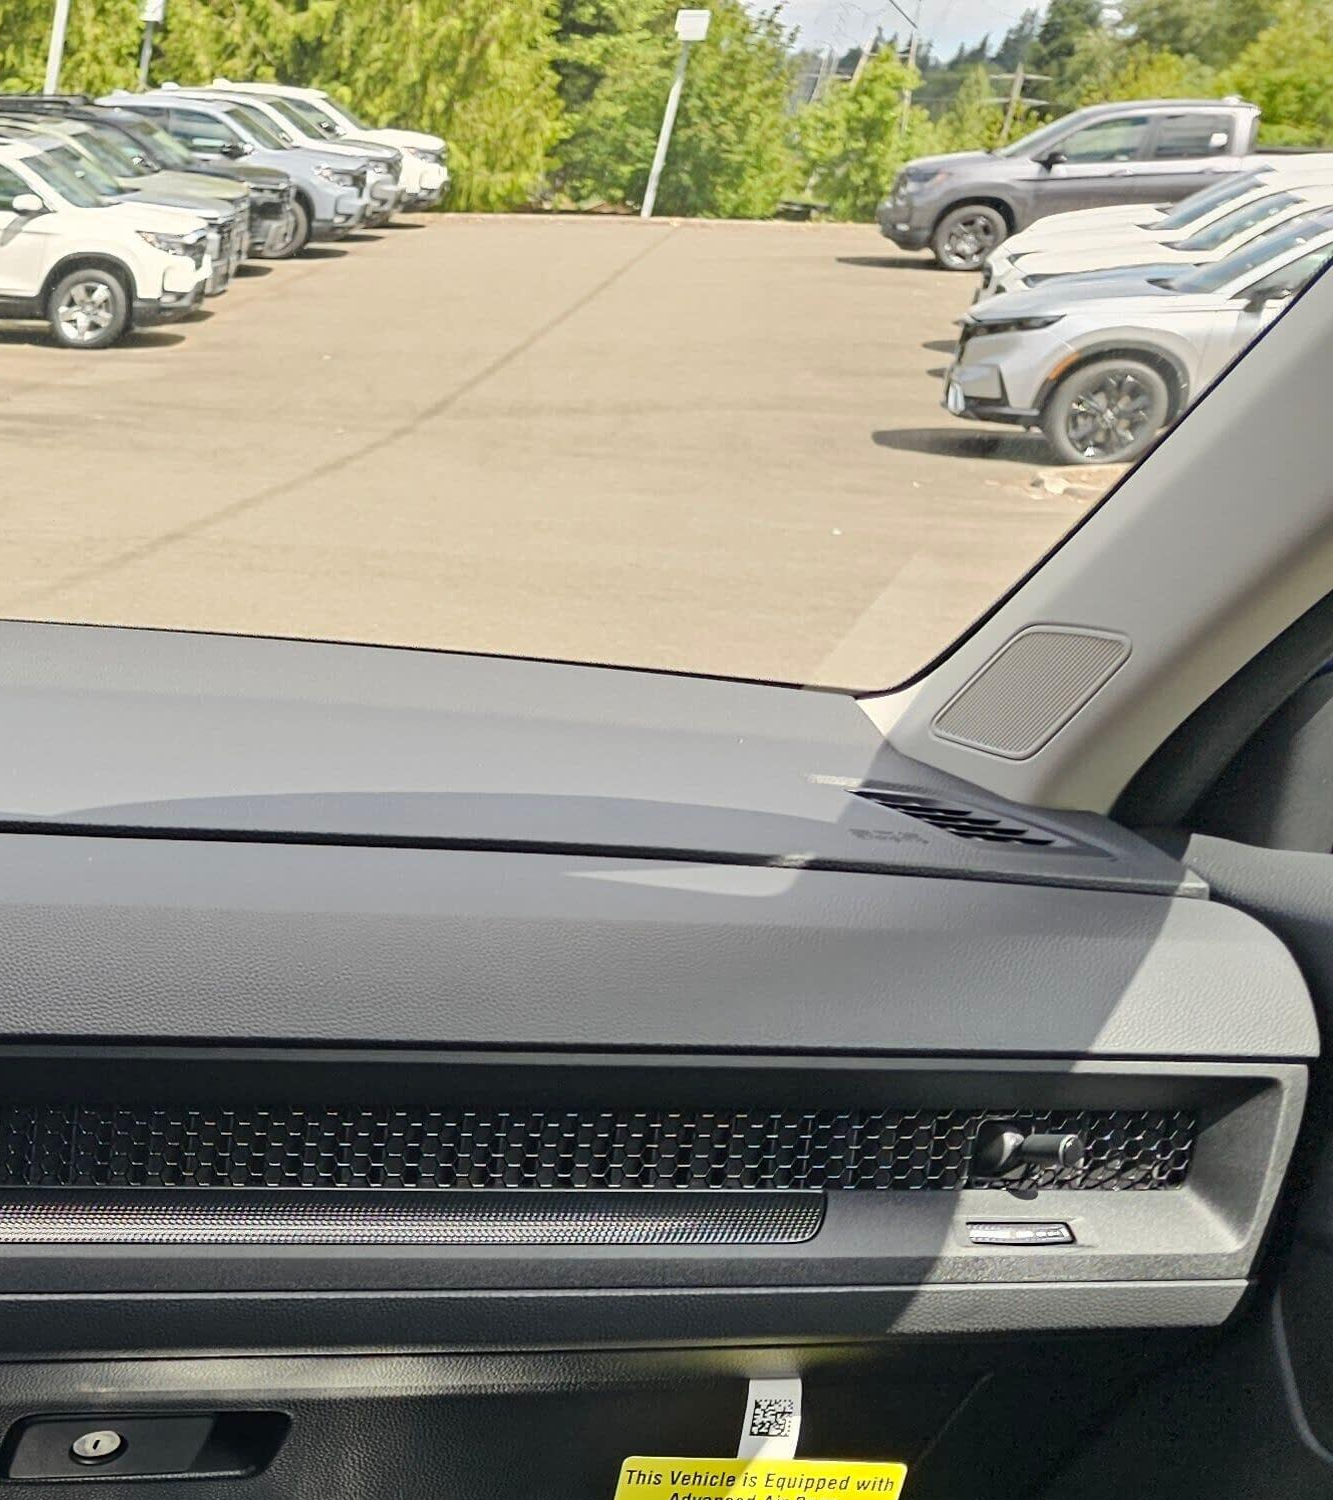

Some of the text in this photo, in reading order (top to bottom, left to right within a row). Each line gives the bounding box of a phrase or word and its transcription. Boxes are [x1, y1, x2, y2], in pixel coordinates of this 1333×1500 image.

[626, 1469, 895, 1492] This Vehicle is Equipped with
